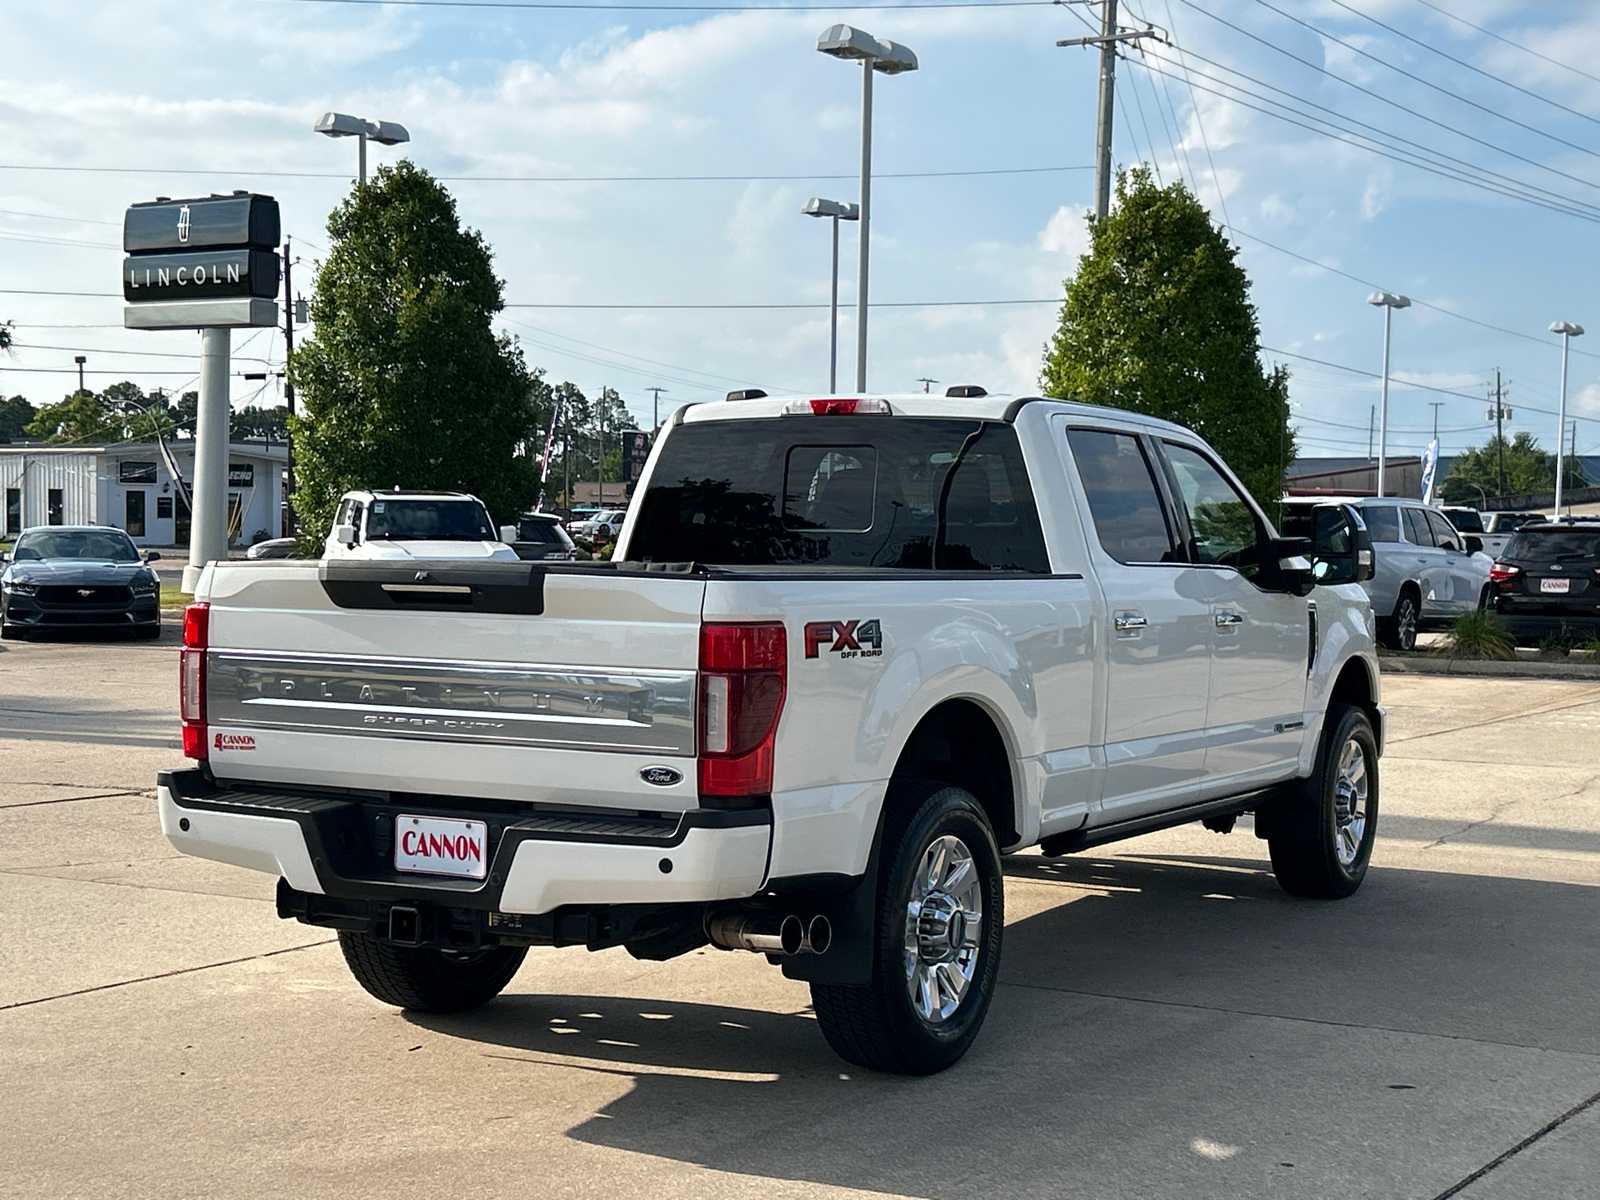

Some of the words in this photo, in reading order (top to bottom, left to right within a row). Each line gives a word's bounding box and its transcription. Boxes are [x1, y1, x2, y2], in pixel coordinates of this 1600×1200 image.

[131, 263, 240, 288] LINCOLN
[228, 470, 252, 480] ECHO
[1542, 581, 1568, 589] CANNON
[804, 619, 883, 659] FX4
[841, 651, 858, 659] OFF
[860, 650, 883, 658] ROAD
[280, 679, 604, 713] PLATINUM
[223, 734, 255, 744] CANNON
[648, 769, 673, 782] Ford
[402, 830, 481, 862] CANNON
